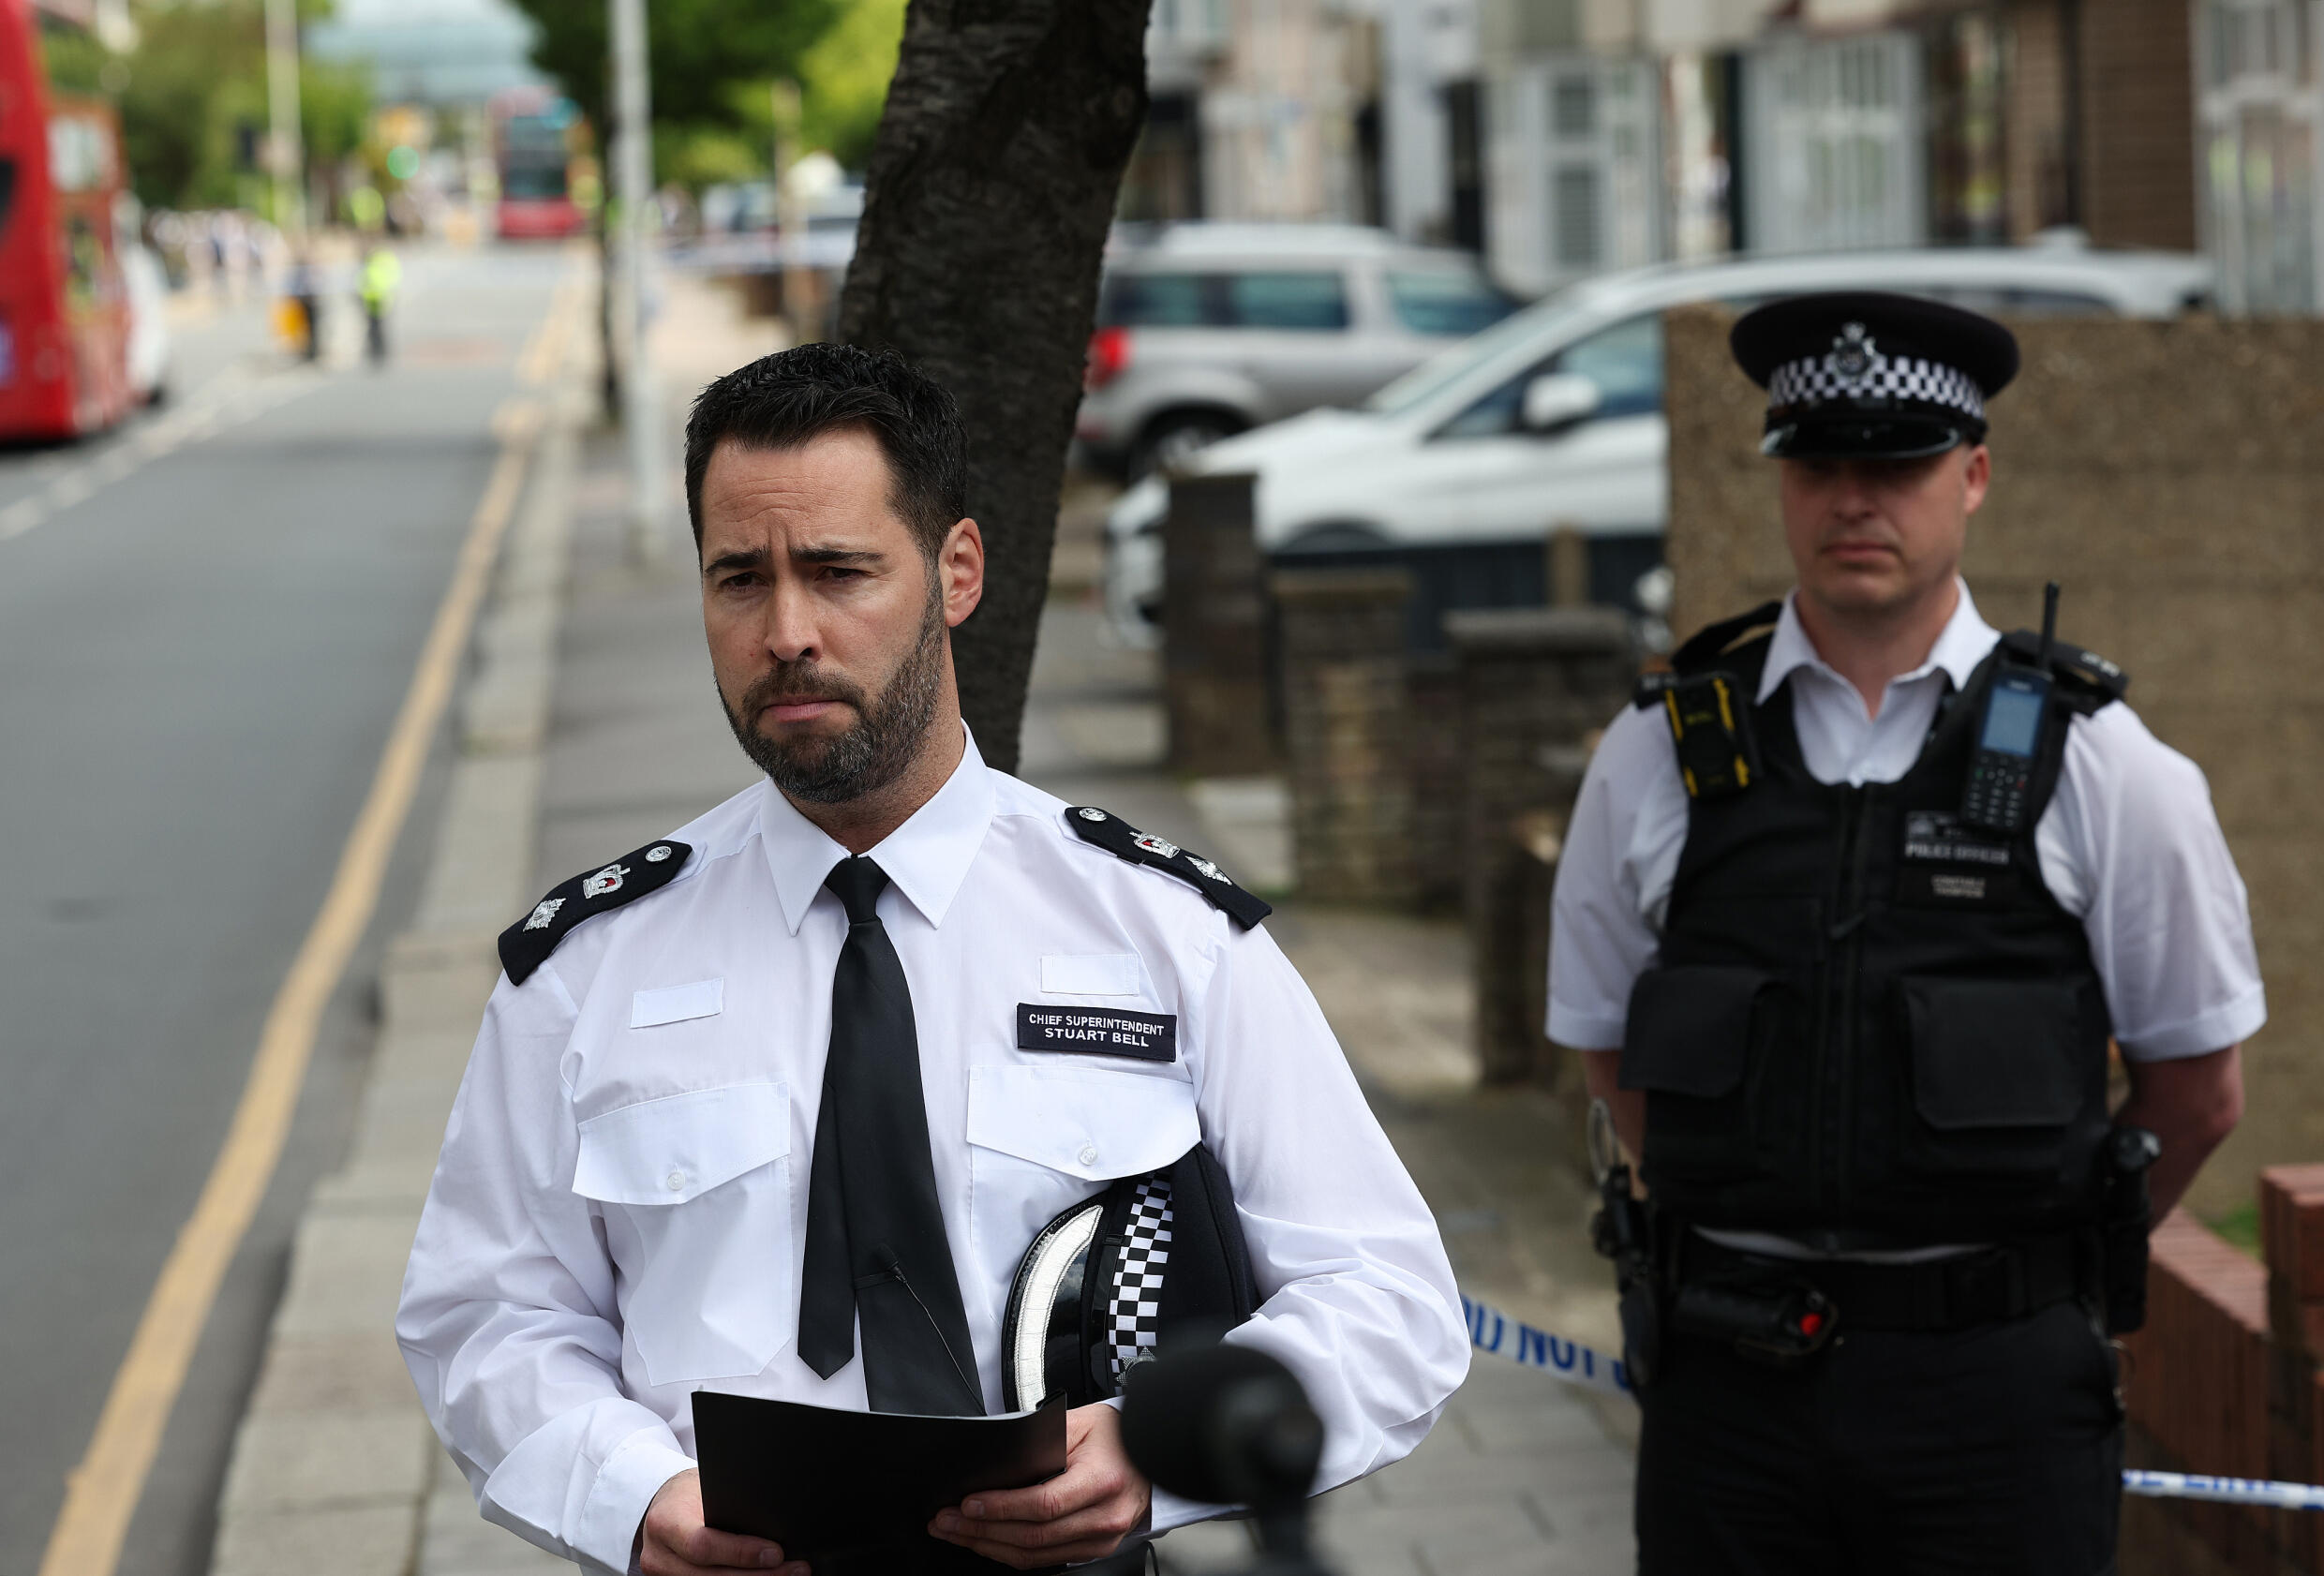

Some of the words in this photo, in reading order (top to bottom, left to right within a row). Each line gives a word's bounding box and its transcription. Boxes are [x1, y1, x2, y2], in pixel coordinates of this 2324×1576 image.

[1029, 1013, 1063, 1026] CHIEF
[1065, 1015, 1164, 1036] SUPERINTENDENT
[1045, 1027, 1107, 1042] STUART
[1111, 1033, 1150, 1048] BELL
